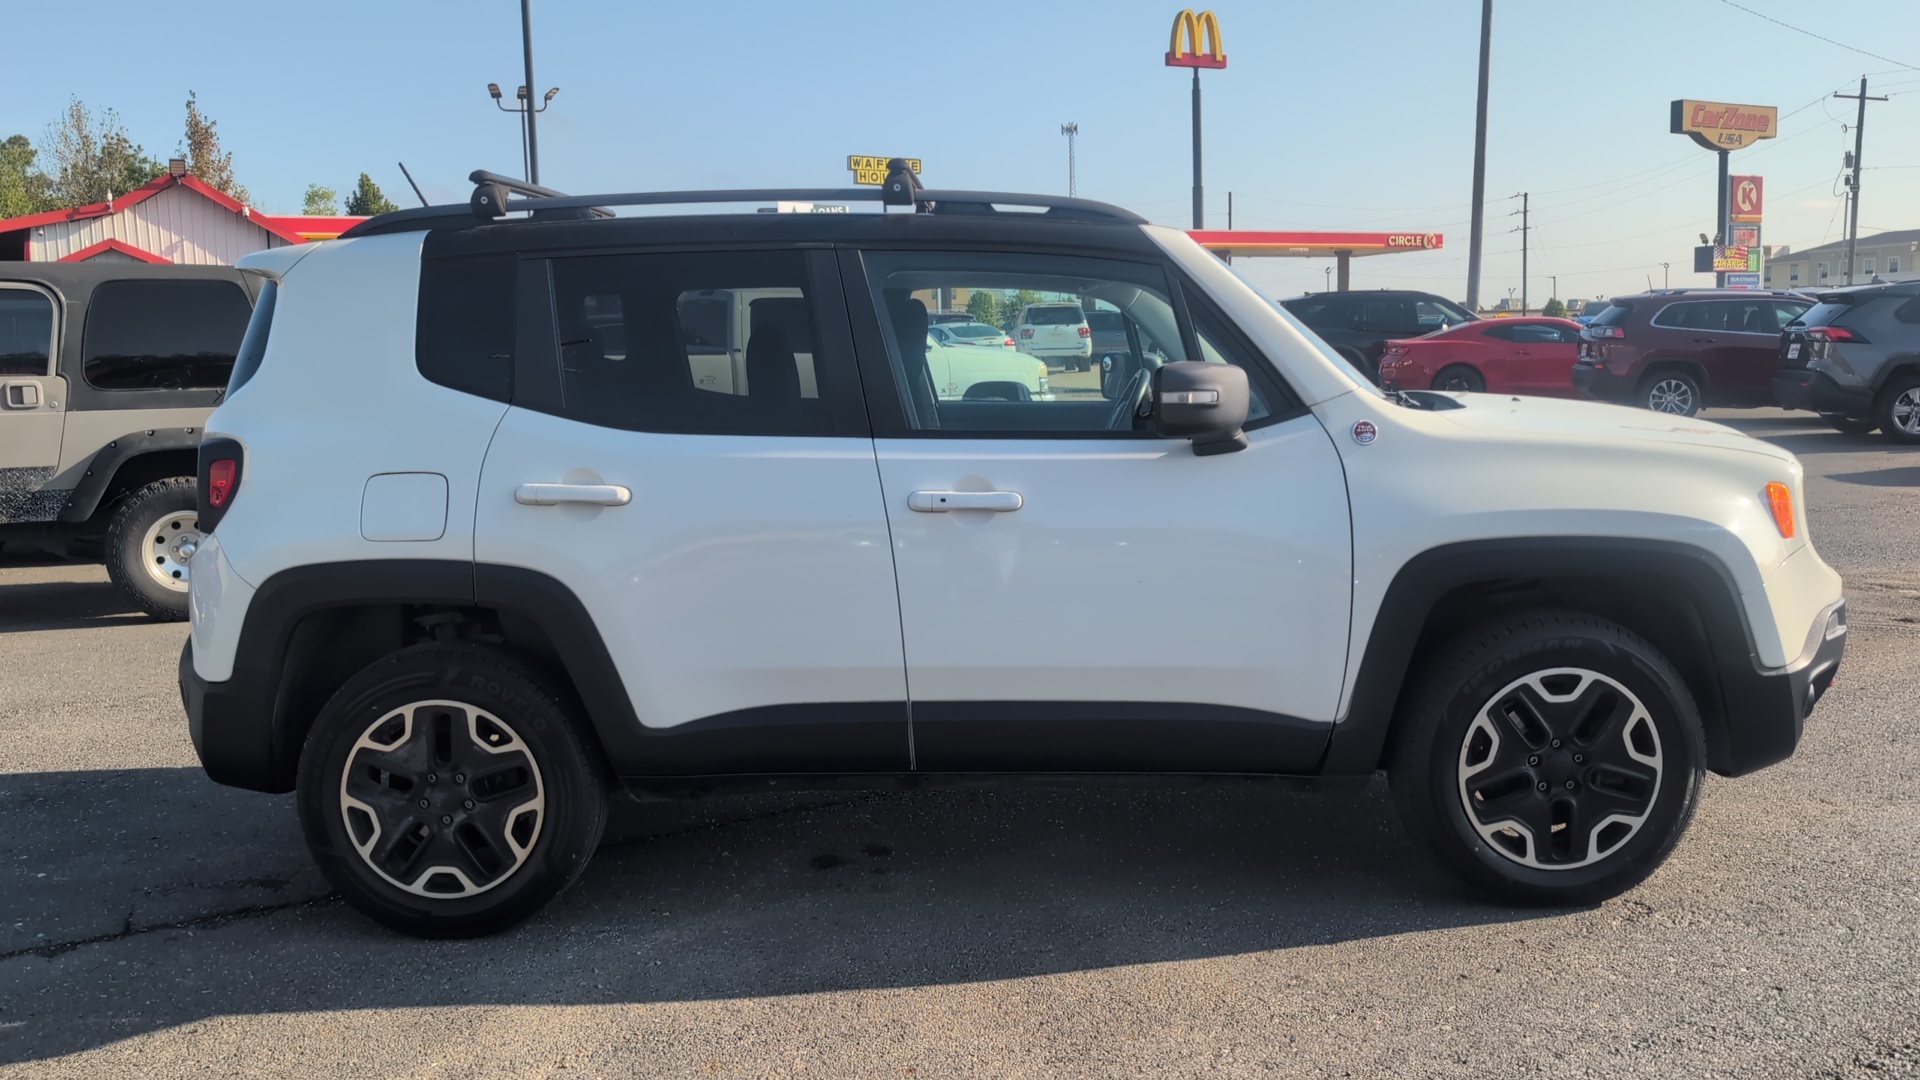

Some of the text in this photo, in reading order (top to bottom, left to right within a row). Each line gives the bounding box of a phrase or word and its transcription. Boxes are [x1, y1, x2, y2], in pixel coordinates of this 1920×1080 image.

[1718, 133, 1743, 145] USA
[852, 157, 918, 171] WAFE
[1740, 185, 1757, 209] K
[1388, 234, 1436, 248] CIRCLE K
[1715, 259, 1746, 268] FINANCE
